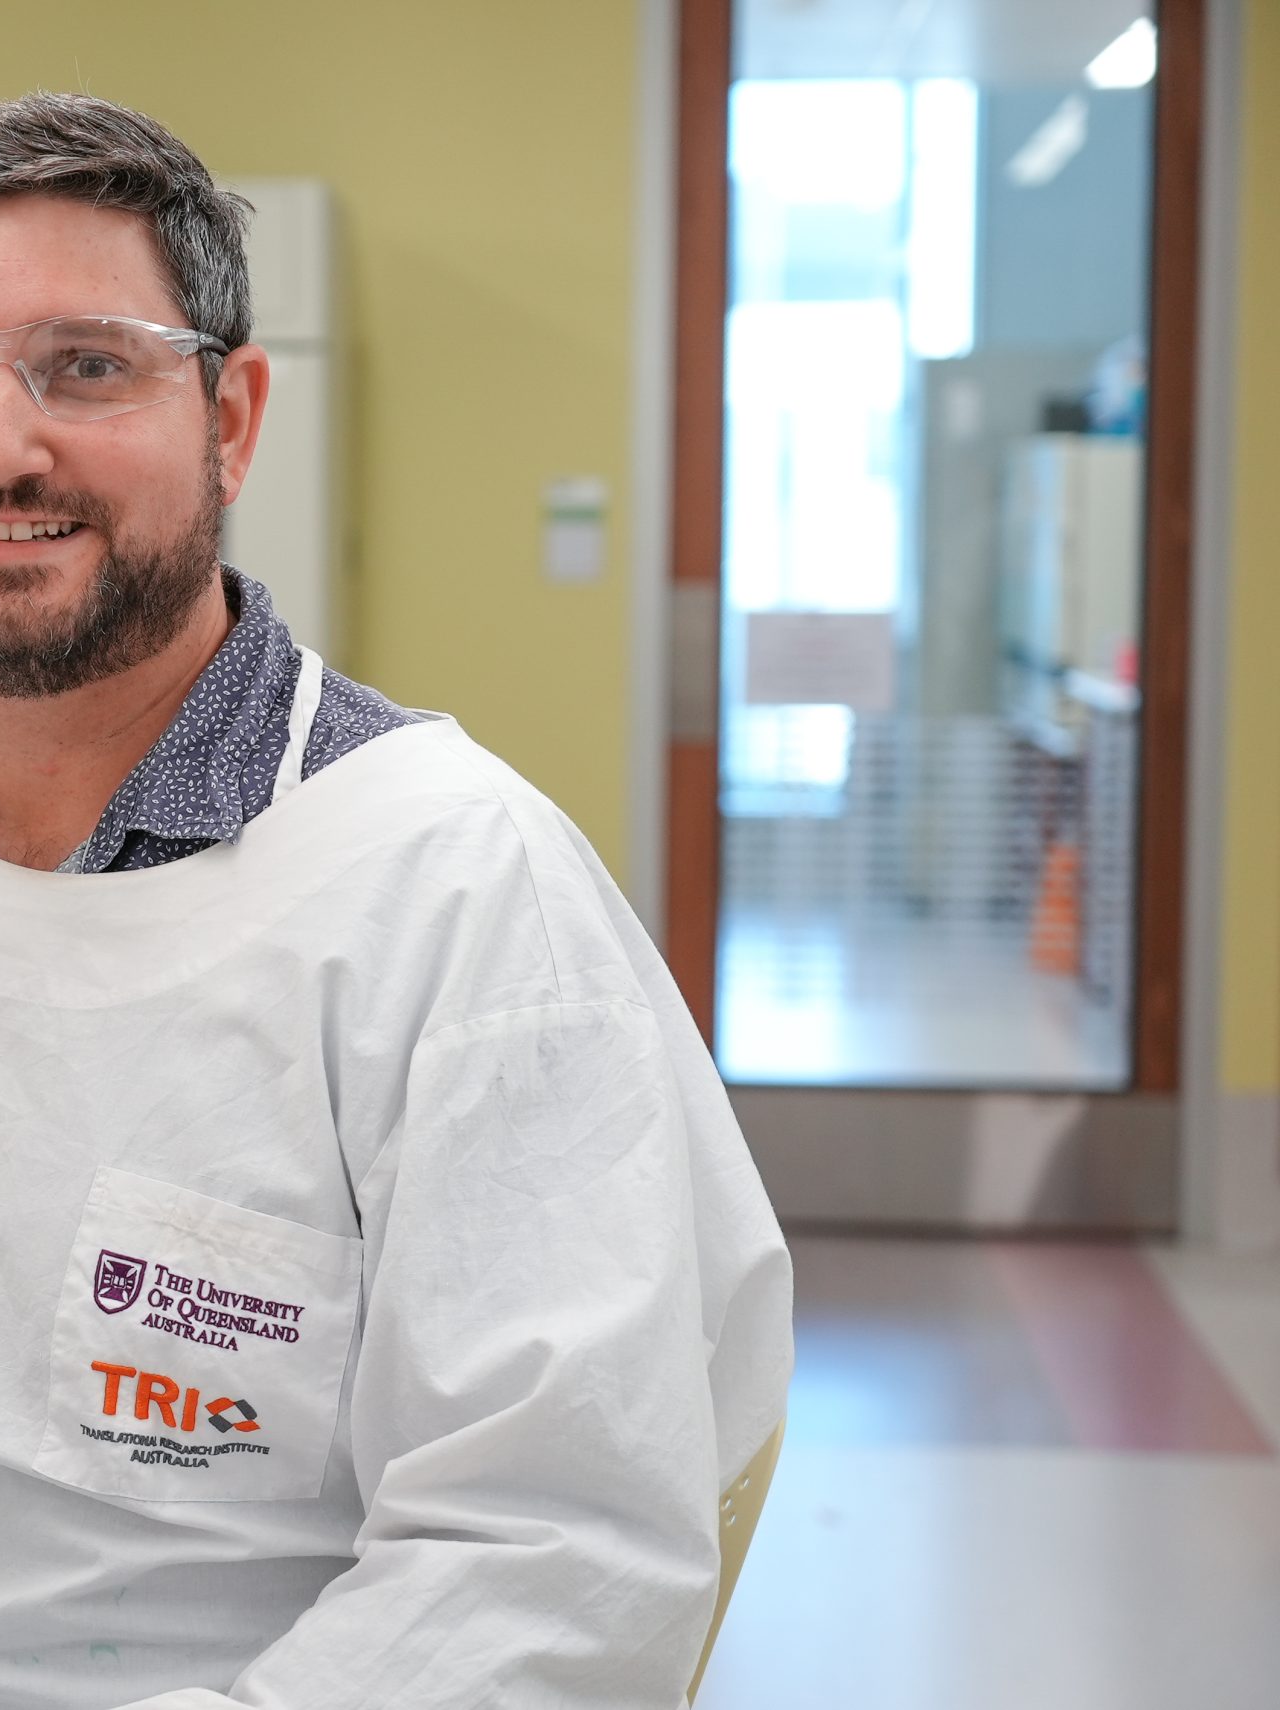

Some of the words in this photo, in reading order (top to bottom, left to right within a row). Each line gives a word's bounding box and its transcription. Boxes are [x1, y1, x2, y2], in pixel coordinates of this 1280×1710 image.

[147, 1288, 174, 1311] OF
[177, 1297, 299, 1344] QUEENSLAND
[155, 1264, 193, 1295] THE
[198, 1278, 305, 1322] UNIVERSITY
[141, 1313, 239, 1351] AUSTRALIA
[91, 1360, 200, 1432] TRI
[80, 1423, 157, 1447] TRANSLATIONAL
[159, 1437, 211, 1456] RESEARCH
[213, 1443, 270, 1456] INSTITUTE
[130, 1449, 210, 1468] AUSTRALIA
